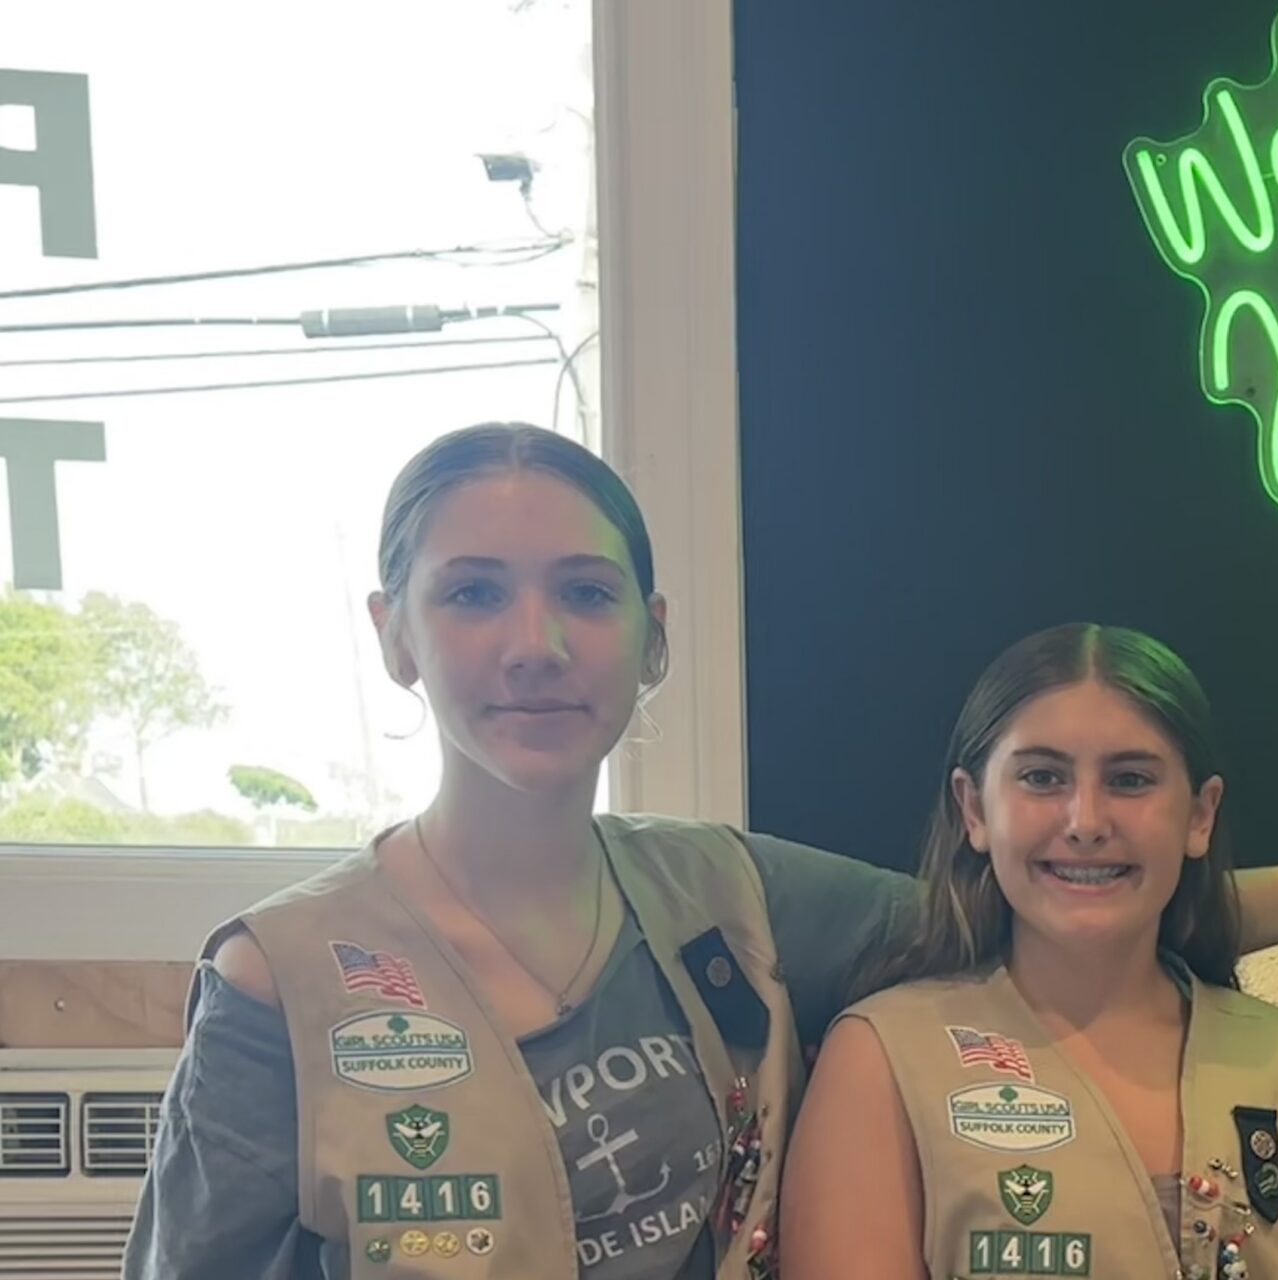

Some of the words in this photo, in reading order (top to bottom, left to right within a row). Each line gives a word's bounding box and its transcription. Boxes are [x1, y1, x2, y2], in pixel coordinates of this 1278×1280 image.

[371, 1032, 433, 1047] SCOUTS
[342, 1059, 406, 1073] SUFFOLK
[407, 1057, 464, 1070] COUNTY
[960, 1121, 1015, 1134] SUFFOLK
[1016, 1123, 1066, 1135] COUNTY
[366, 1180, 492, 1216] 1416
[976, 1237, 1085, 1269] 1416
